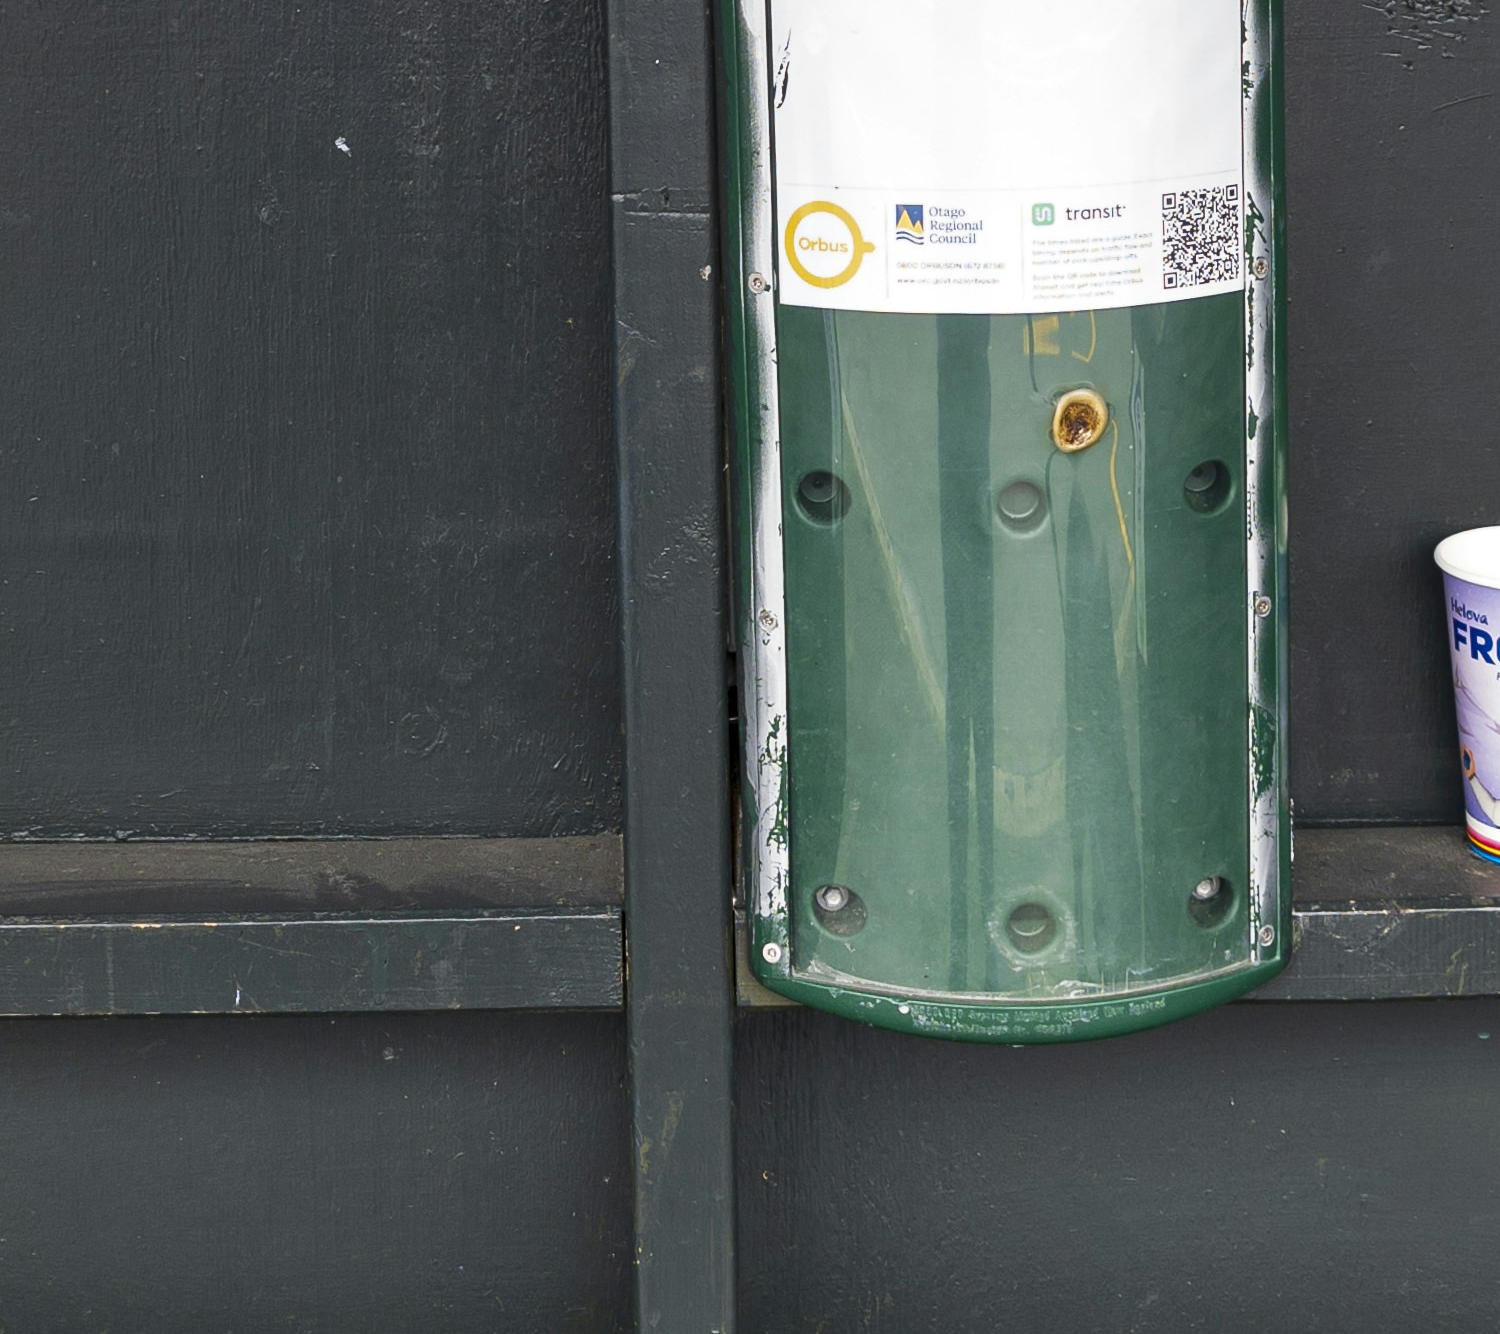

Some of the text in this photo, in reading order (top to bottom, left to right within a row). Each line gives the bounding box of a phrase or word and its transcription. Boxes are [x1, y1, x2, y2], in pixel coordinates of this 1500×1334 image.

[929, 208, 965, 218] Otago
[1066, 206, 1124, 220] transit
[931, 221, 982, 232] Regional
[799, 237, 848, 252] Orbus
[930, 234, 976, 243] Council
[1451, 597, 1488, 625] Helova
